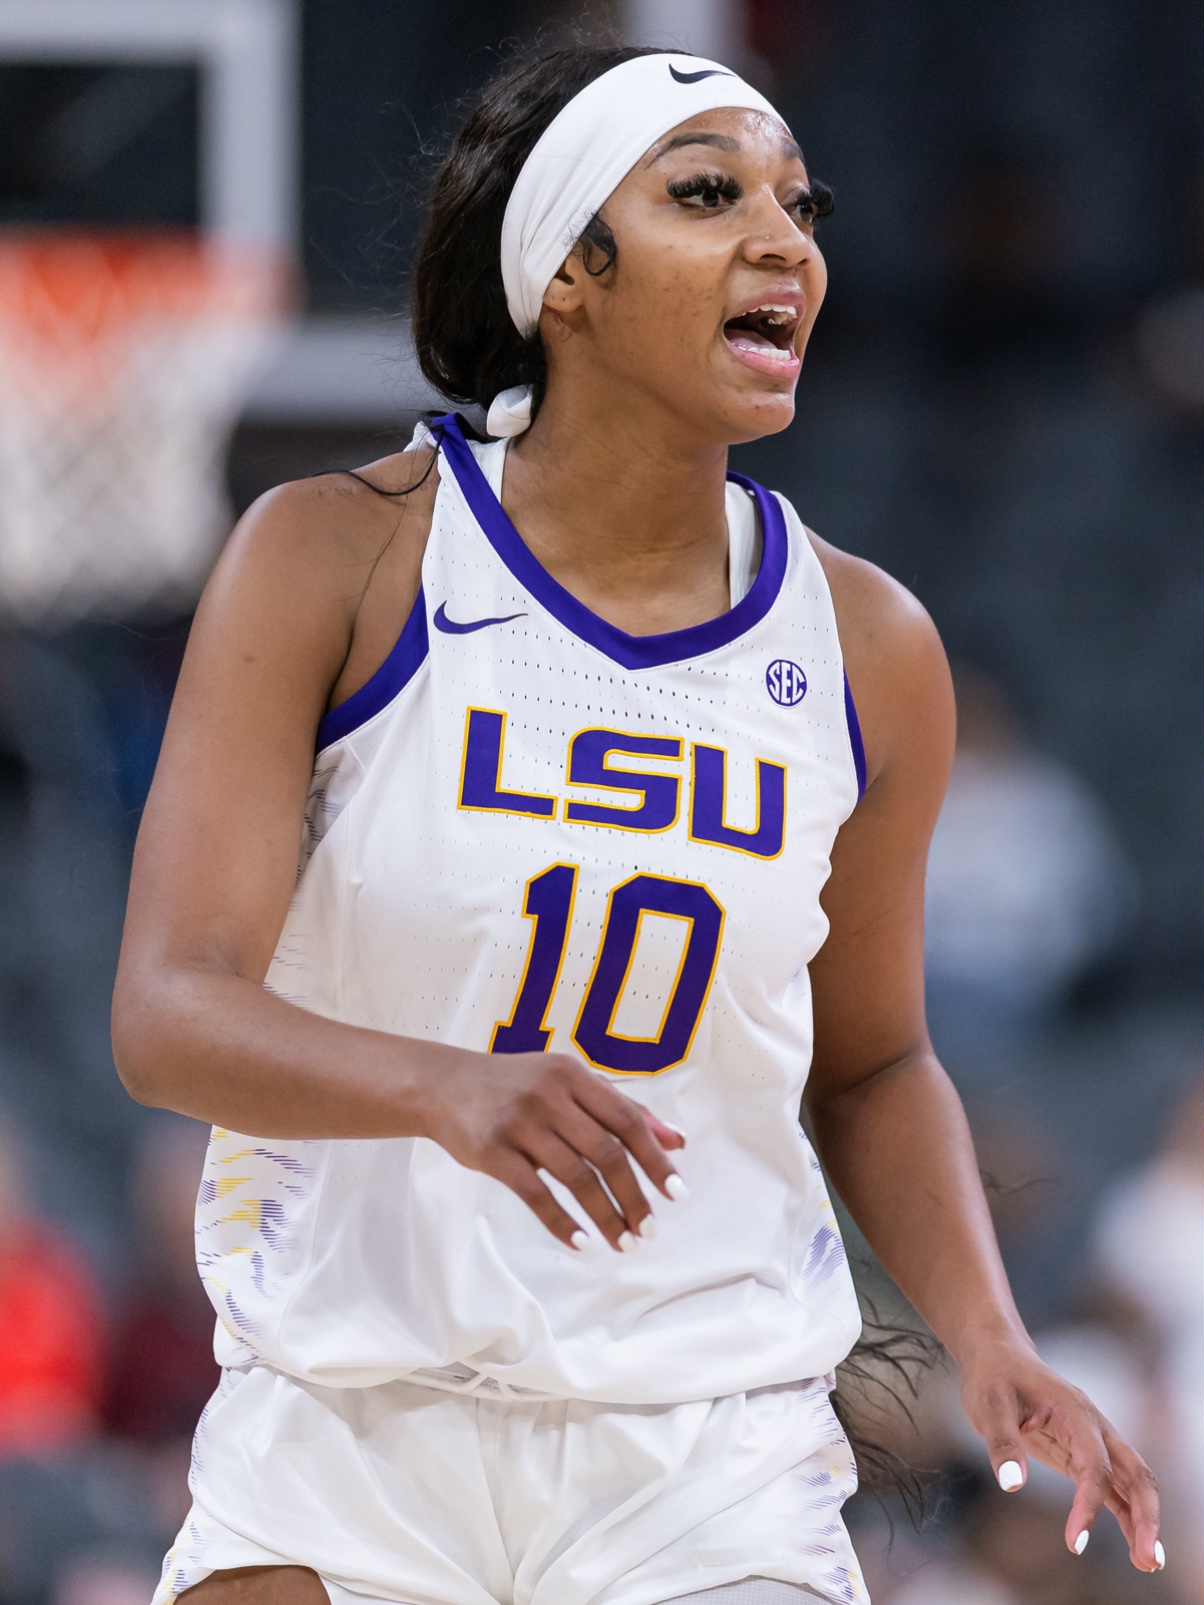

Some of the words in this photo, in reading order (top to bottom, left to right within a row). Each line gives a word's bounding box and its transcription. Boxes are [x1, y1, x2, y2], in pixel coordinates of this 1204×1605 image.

[766, 660, 807, 705] SEC
[457, 706, 787, 860] LSU
[488, 862, 726, 1075] 10
